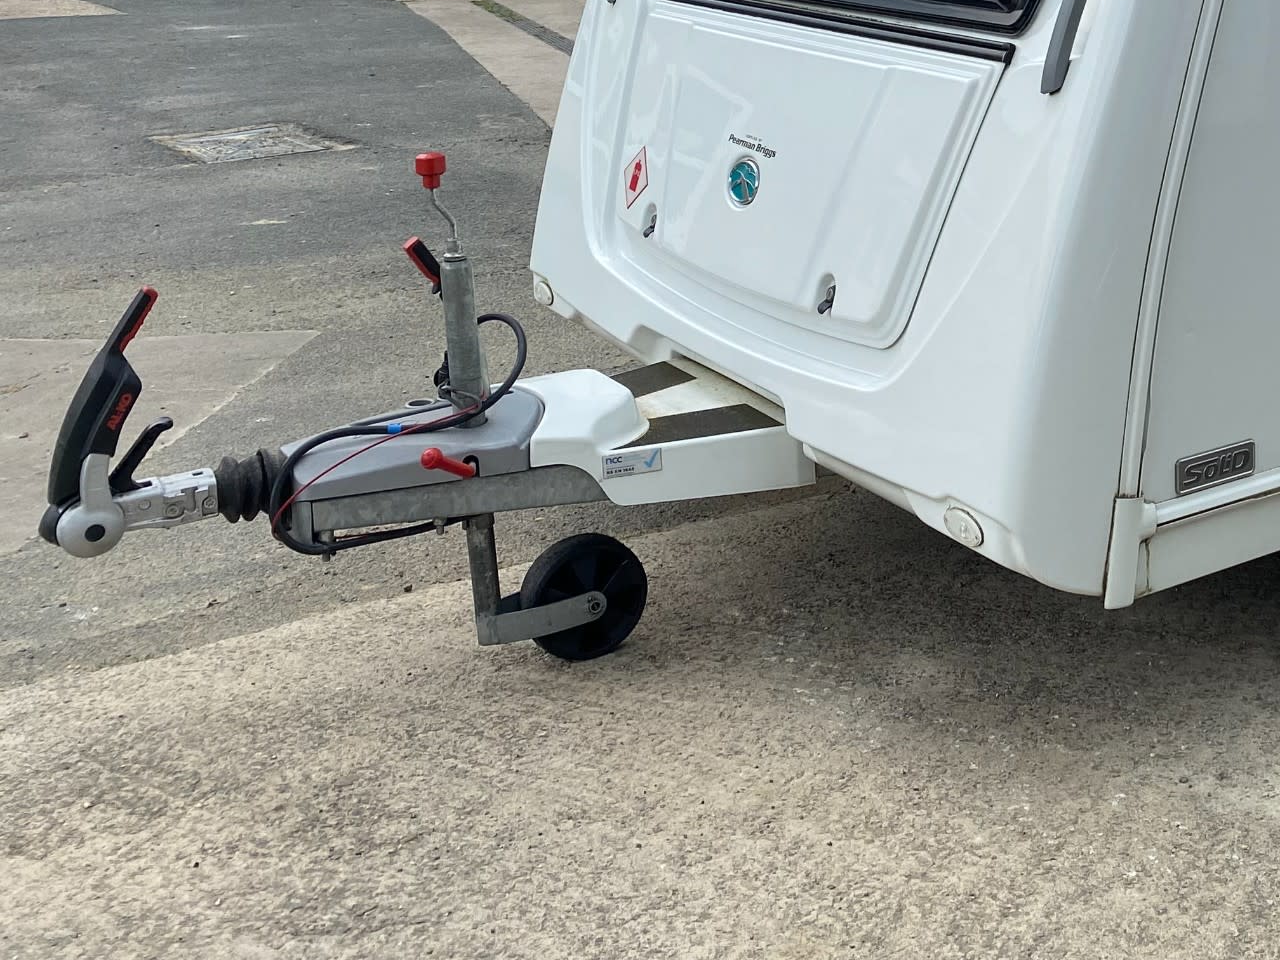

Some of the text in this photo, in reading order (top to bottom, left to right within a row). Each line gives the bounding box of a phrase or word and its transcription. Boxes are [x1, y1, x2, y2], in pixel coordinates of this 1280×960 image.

[728, 134, 756, 151] Pearman
[755, 143, 777, 158] Briggs
[605, 456, 623, 465] ncc
